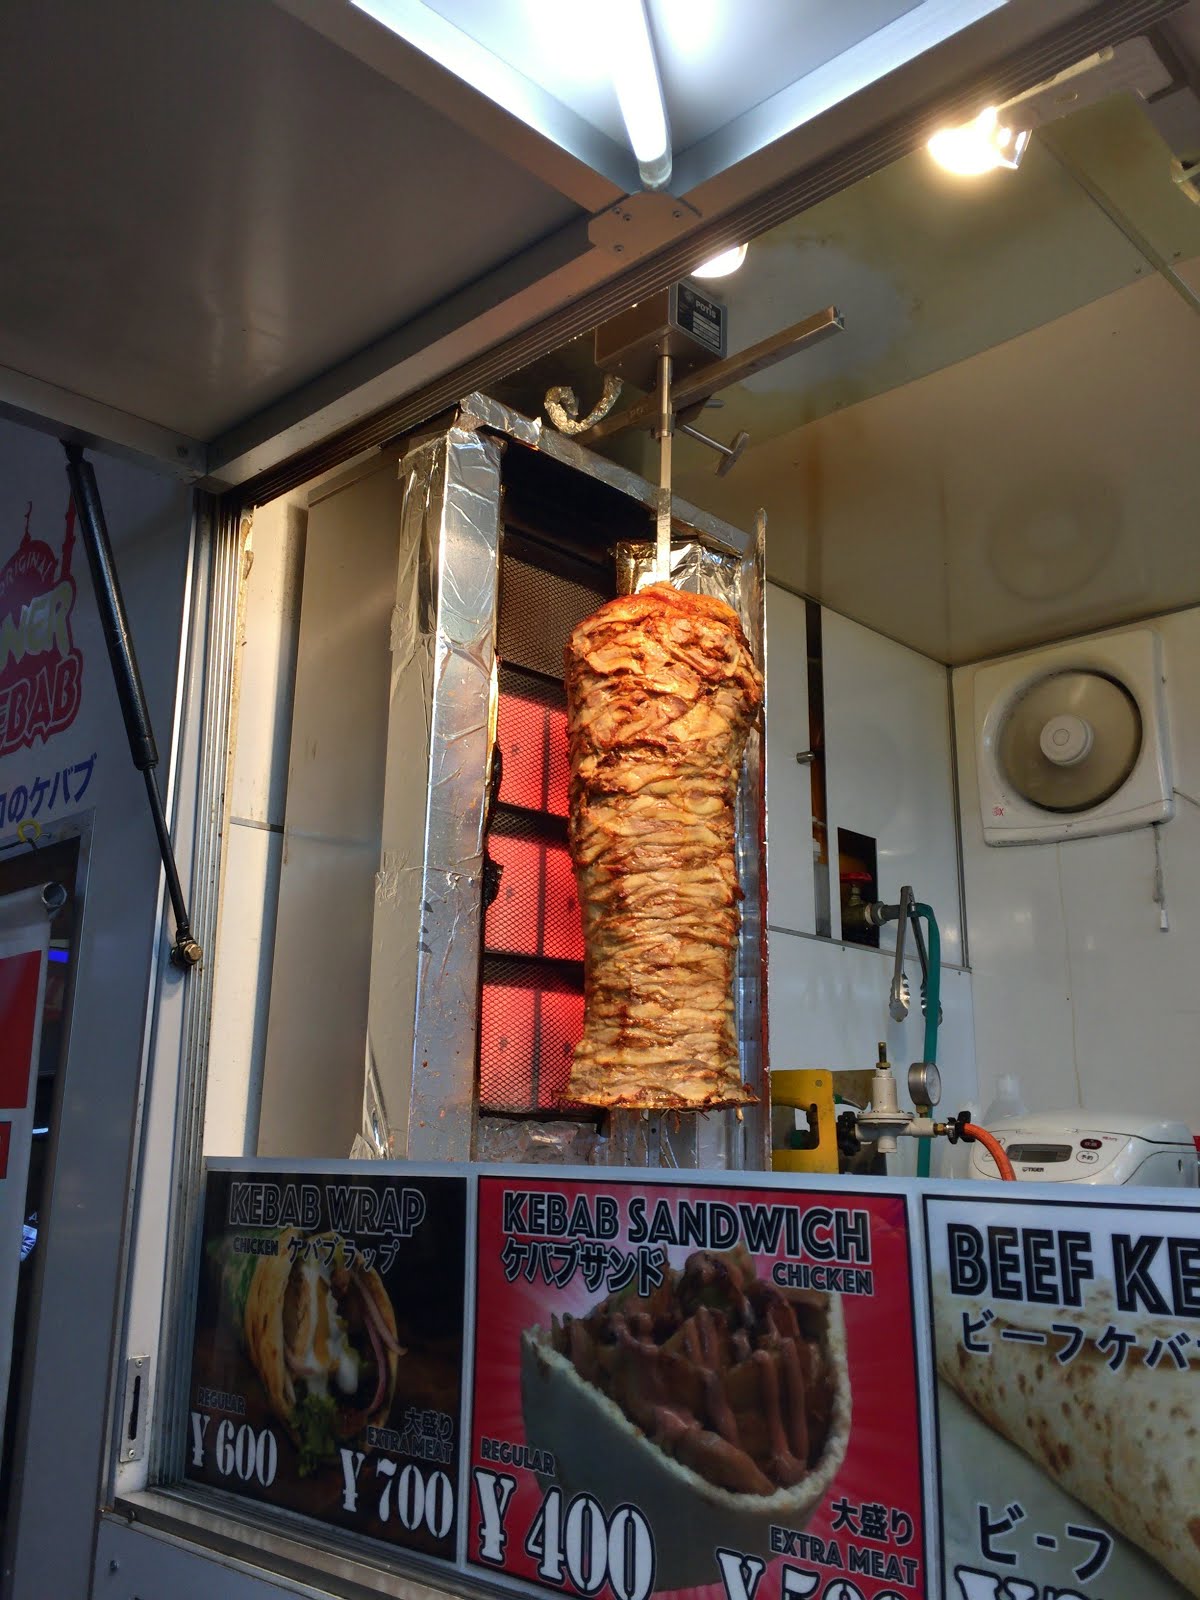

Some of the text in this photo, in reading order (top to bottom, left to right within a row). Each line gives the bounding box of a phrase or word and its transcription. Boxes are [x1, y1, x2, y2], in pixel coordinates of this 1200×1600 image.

[229, 1182, 426, 1238] KEBAB WRAP
[503, 1191, 873, 1263] KEBAB SANDWICH
[233, 1236, 279, 1257] CHICKEN
[287, 1236, 400, 1275] ケバブラップ
[501, 1236, 665, 1297] ケバブサンド
[946, 1222, 1094, 1307] BEEF
[771, 1262, 873, 1296] CHICKEN
[961, 1307, 1200, 1372] ビーフケバ
[366, 1424, 454, 1465] EXTRA MEAT
[404, 1406, 454, 1442] 大盛り
[480, 1437, 556, 1476] REGULAR
[831, 1497, 915, 1547] 大盛り
[769, 1524, 844, 1569] EXTRA
[847, 1542, 920, 1588] MEAT
